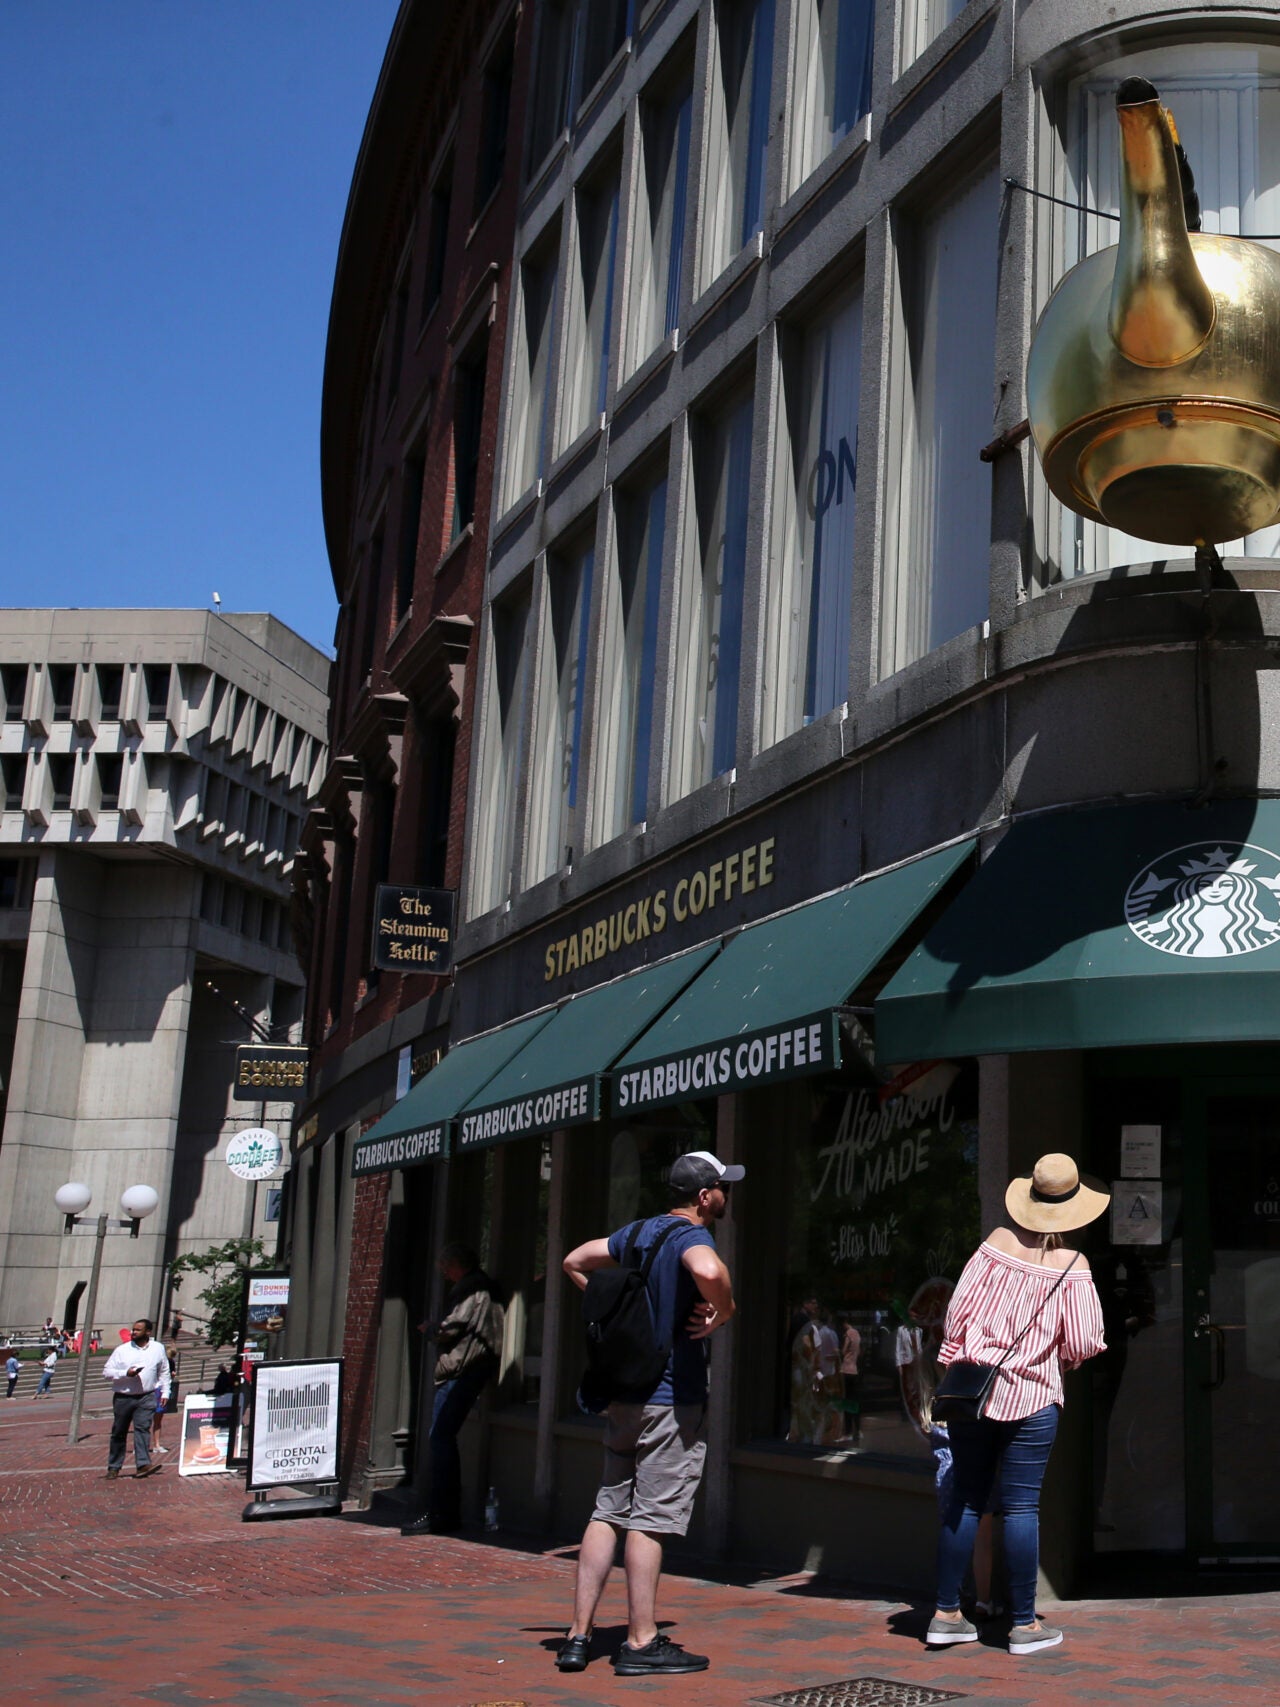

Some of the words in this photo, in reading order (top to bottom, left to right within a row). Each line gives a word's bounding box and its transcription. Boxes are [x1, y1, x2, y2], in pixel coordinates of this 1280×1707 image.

[399, 897, 432, 916] The
[544, 889, 667, 981] STARBUCKS
[673, 837, 775, 922] COFFEE
[380, 919, 449, 942] Steaming
[389, 942, 438, 963] Kettle
[240, 1060, 309, 1074] DUNKIN'
[619, 1048, 730, 1107] STARBUCKS
[734, 1023, 822, 1079] COFFEE
[239, 1073, 304, 1087] DONUTS
[462, 1099, 533, 1144] STARBUCKS
[534, 1084, 588, 1124] COFFEE
[228, 1148, 281, 1166] COCOBEET
[354, 1136, 405, 1170] STARBUCKS
[405, 1128, 442, 1161] COFFEE
[862, 1128, 931, 1200] MADE
[1128, 1195, 1148, 1218] A
[839, 1222, 866, 1262] Bliss
[868, 1222, 892, 1257] Out
[265, 1445, 327, 1459] CITIDENTAL
[273, 1456, 320, 1468] BOSTON
